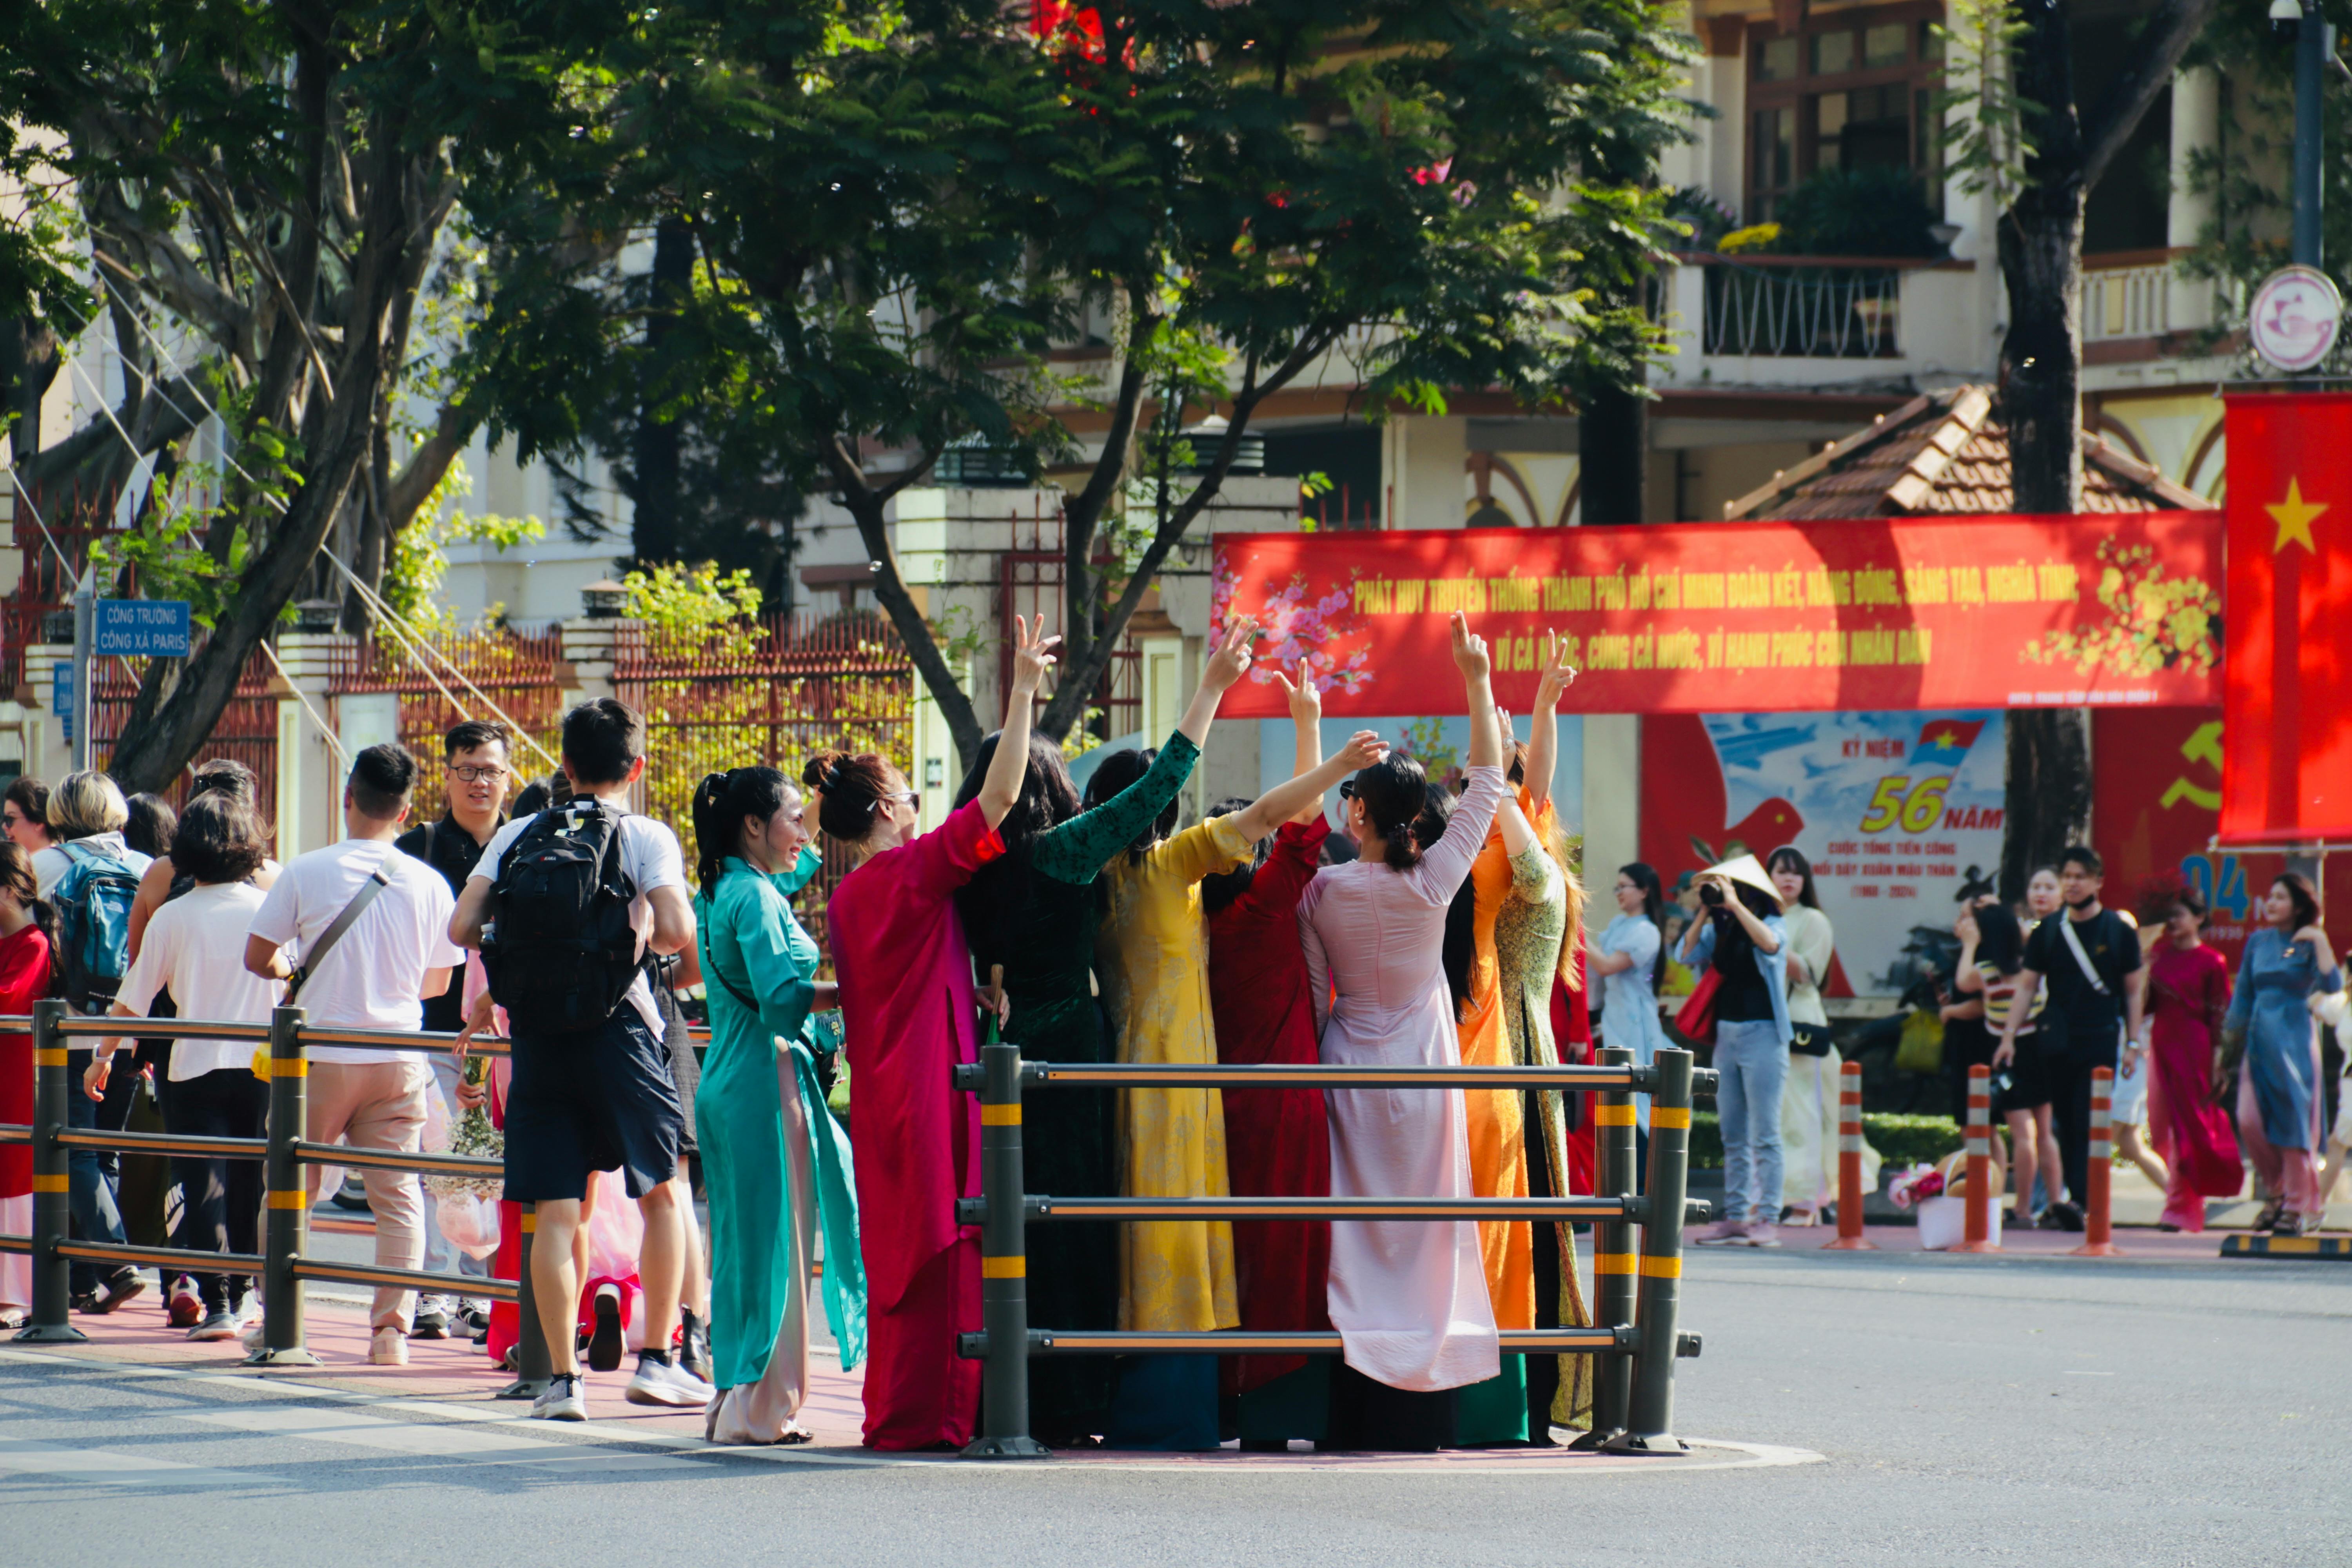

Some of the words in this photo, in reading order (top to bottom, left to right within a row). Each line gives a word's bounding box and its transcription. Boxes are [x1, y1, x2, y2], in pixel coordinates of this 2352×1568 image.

[1354, 573, 1392, 614] PHÁT
[1396, 579, 1425, 613] HUY
[107, 604, 134, 624] CÔNG
[101, 630, 132, 649] CÔNG
[134, 630, 150, 649] XÃ
[153, 633, 185, 650] PARIS
[1858, 775, 1952, 834] 56
[1943, 805, 2005, 829] NĂM
